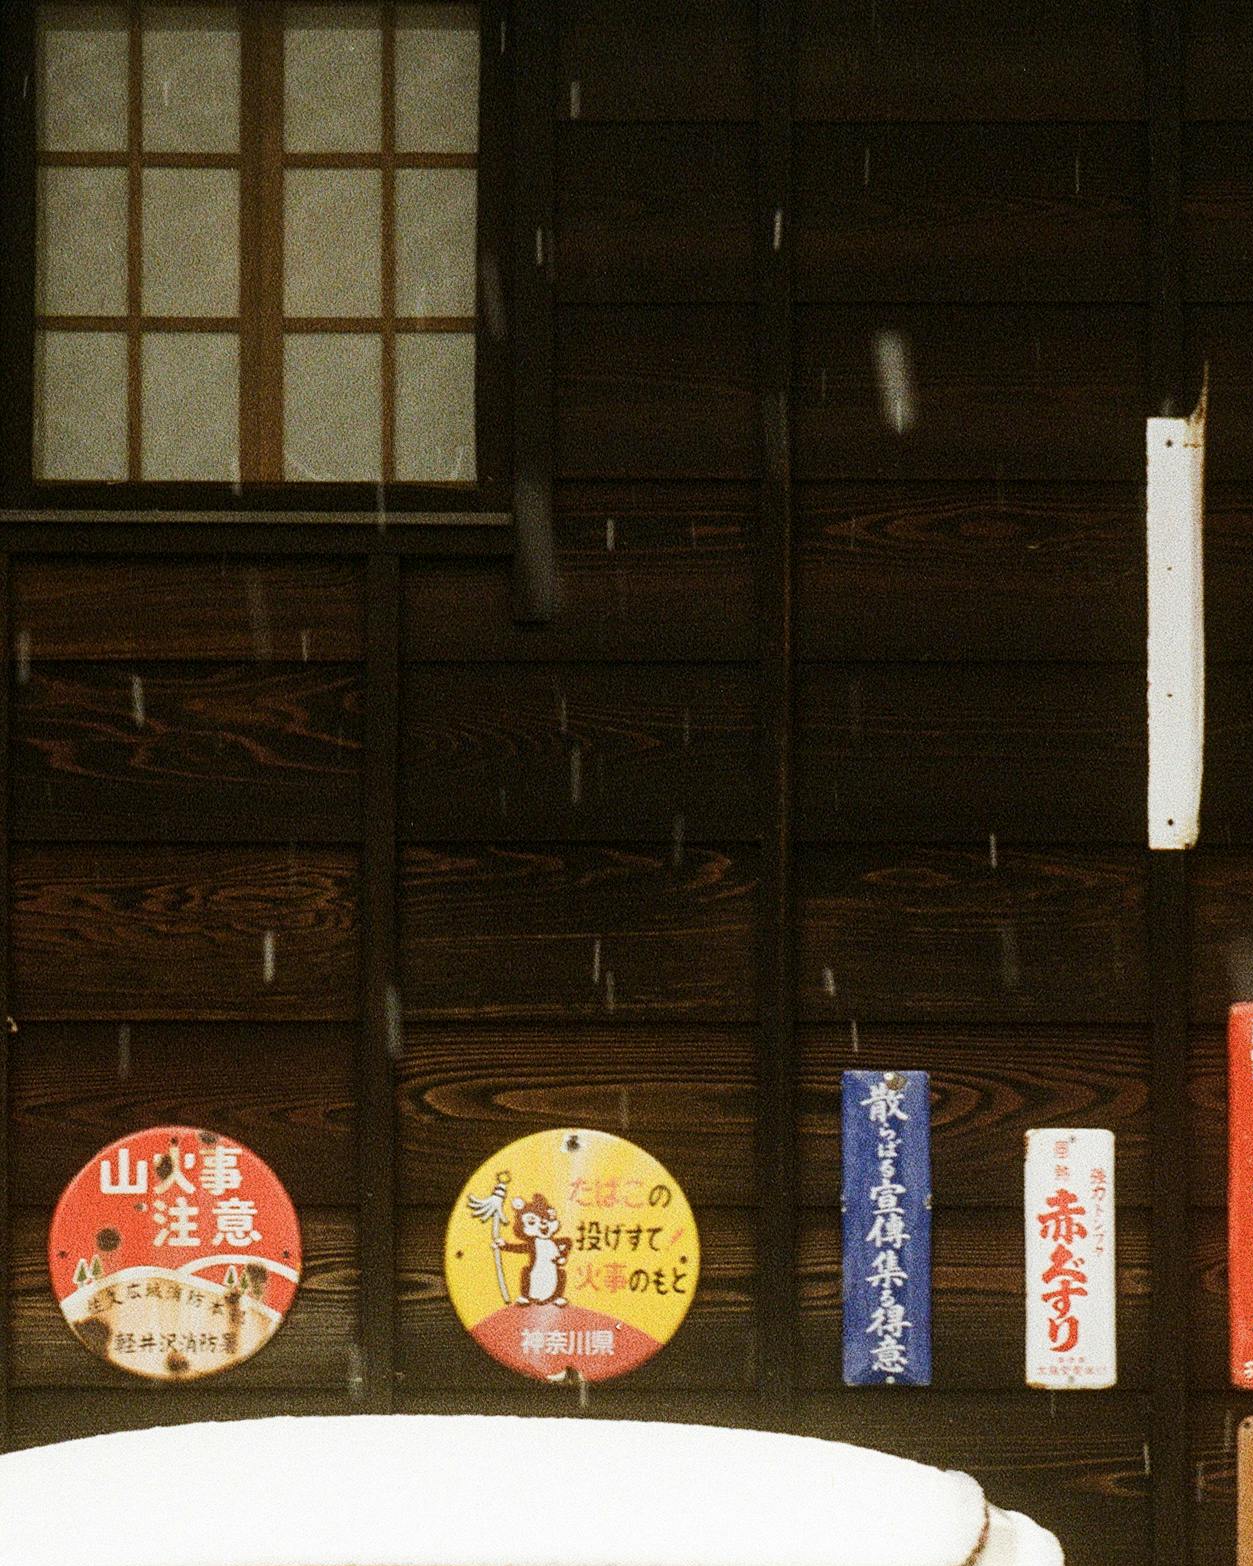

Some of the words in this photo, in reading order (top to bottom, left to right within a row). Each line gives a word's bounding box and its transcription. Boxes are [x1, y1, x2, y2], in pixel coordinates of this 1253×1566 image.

[100, 1145, 244, 1196] 山火事
[569, 1175, 672, 1209] たばこの
[152, 1196, 263, 1248] 注意
[574, 1261, 688, 1296] 火事のもと
[1036, 1187, 1088, 1353] 赤ぐすり
[520, 1328, 616, 1357] 神奈川県
